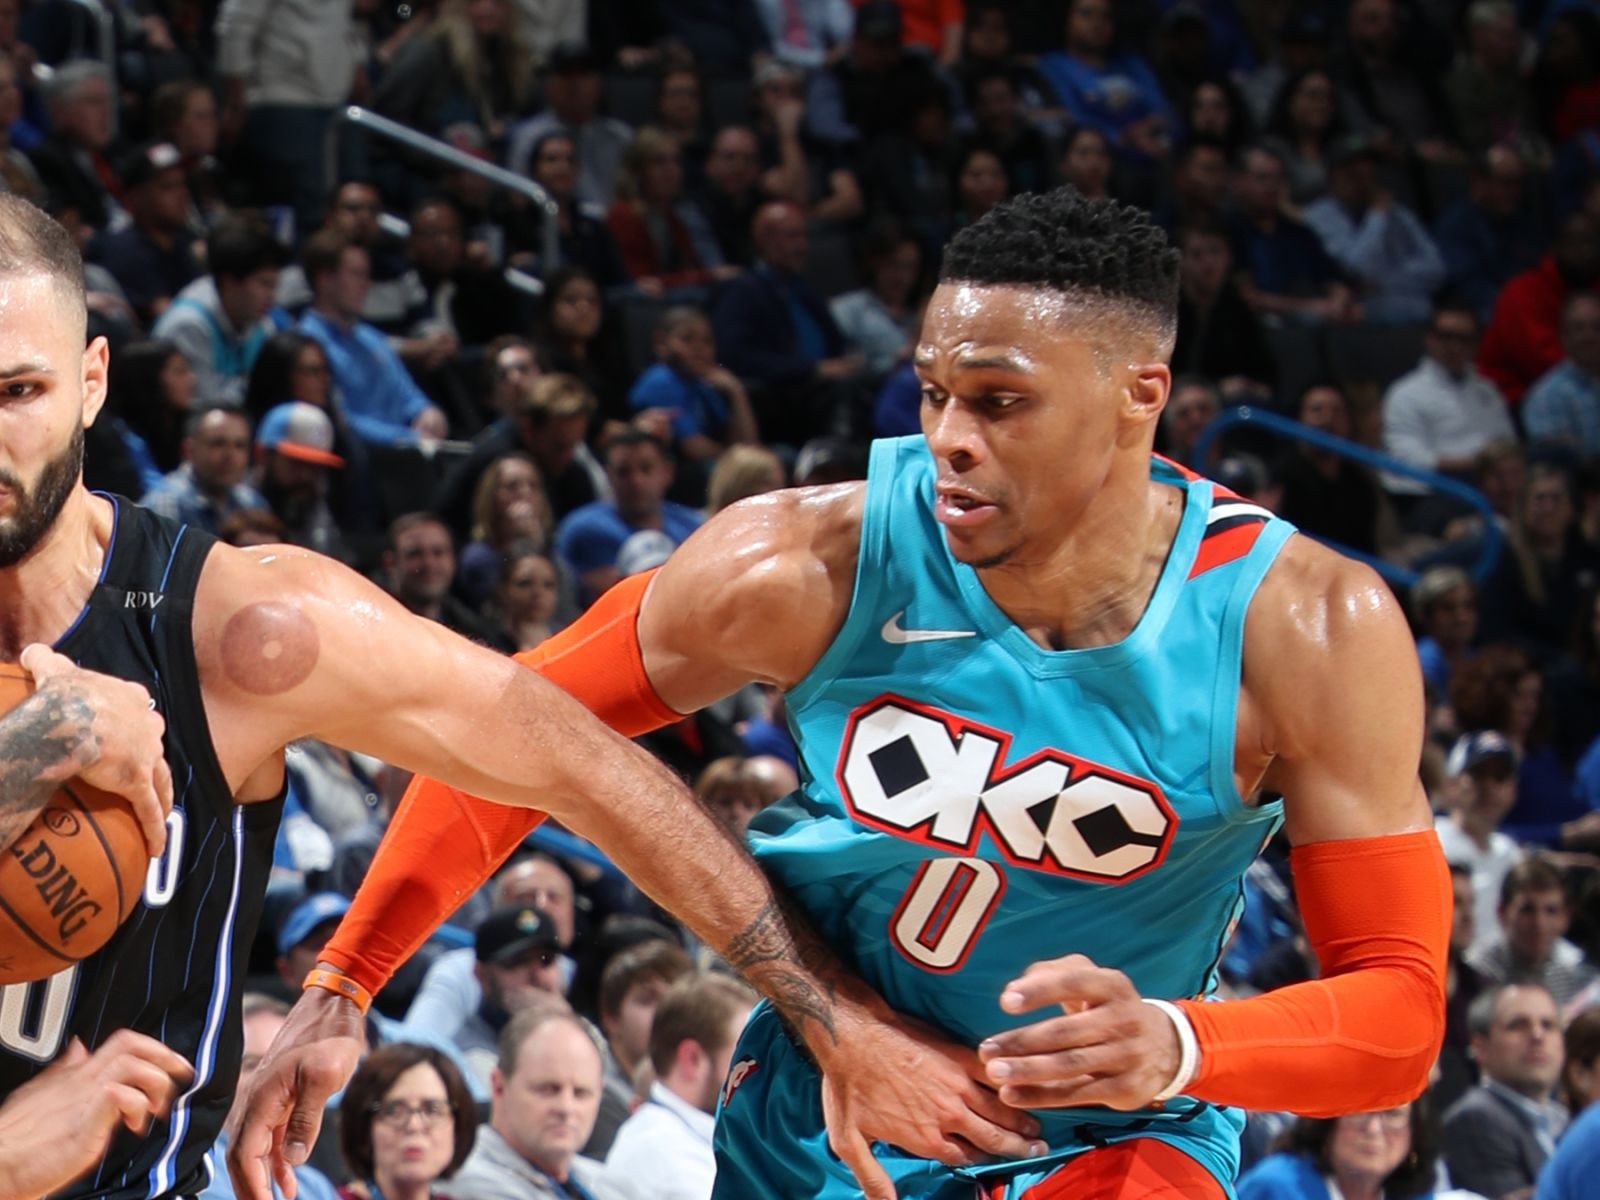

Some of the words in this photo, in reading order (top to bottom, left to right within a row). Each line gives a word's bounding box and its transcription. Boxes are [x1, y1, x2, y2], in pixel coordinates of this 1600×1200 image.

[124, 591, 164, 609] RDV
[835, 693, 1180, 884] OKC
[888, 856, 1007, 975] 0
